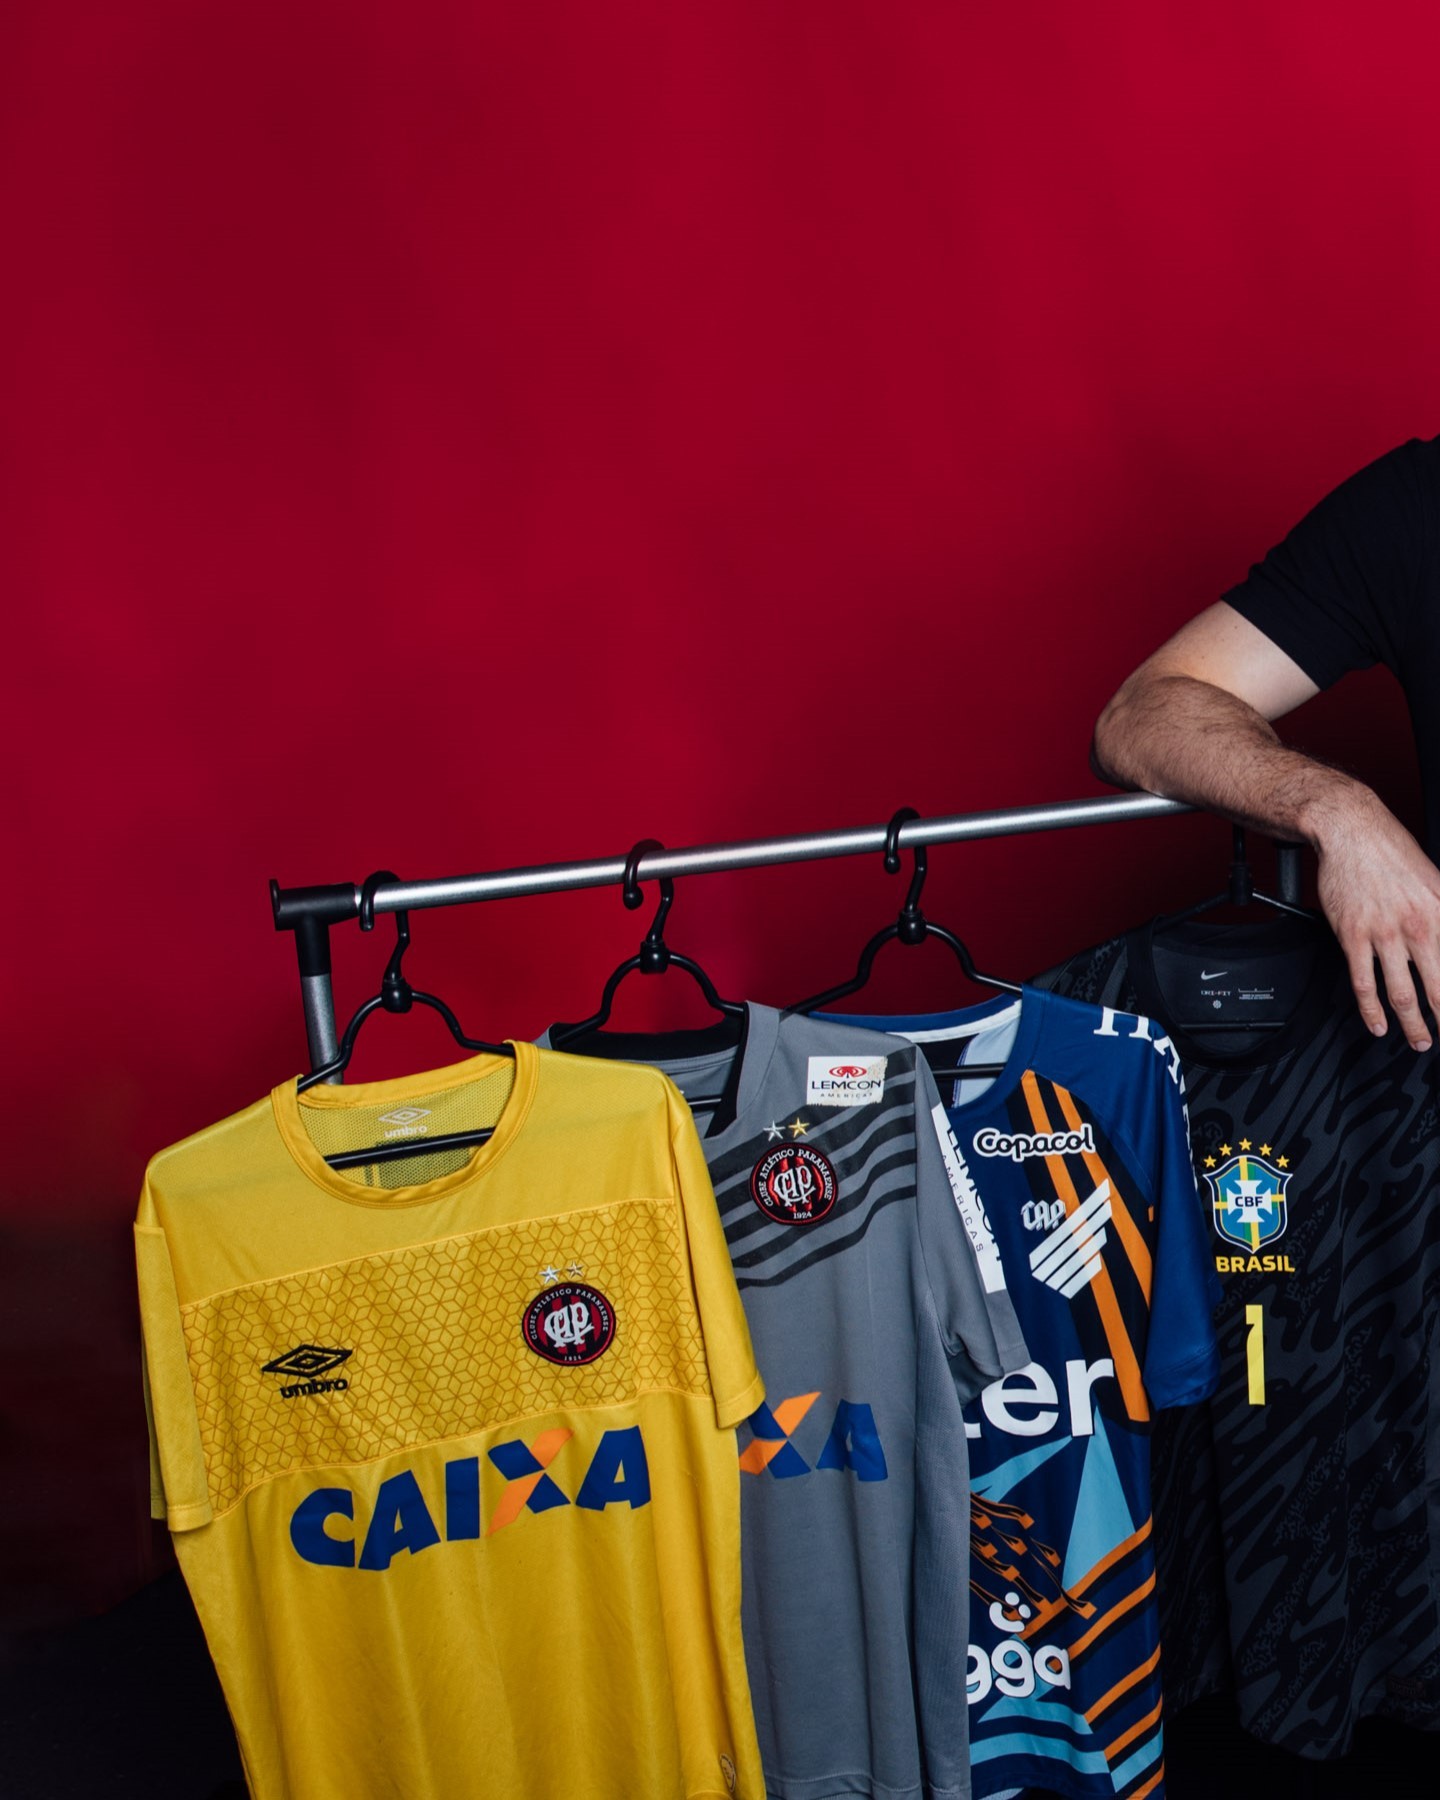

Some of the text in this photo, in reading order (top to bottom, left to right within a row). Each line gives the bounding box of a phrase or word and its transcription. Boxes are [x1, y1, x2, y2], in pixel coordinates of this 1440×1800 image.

[811, 1080, 882, 1090] LEMCON
[384, 1125, 428, 1138] umbro
[974, 1124, 1096, 1161] Copacol
[759, 1148, 795, 1180] ATLÉTICO
[1235, 1196, 1263, 1207] CBF
[1215, 1254, 1295, 1273] BRASIL
[575, 1289, 609, 1332] PARANAENSE
[1245, 1304, 1266, 1405] 1
[280, 1378, 348, 1398] umbro
[289, 1425, 652, 1571] CAIXA
